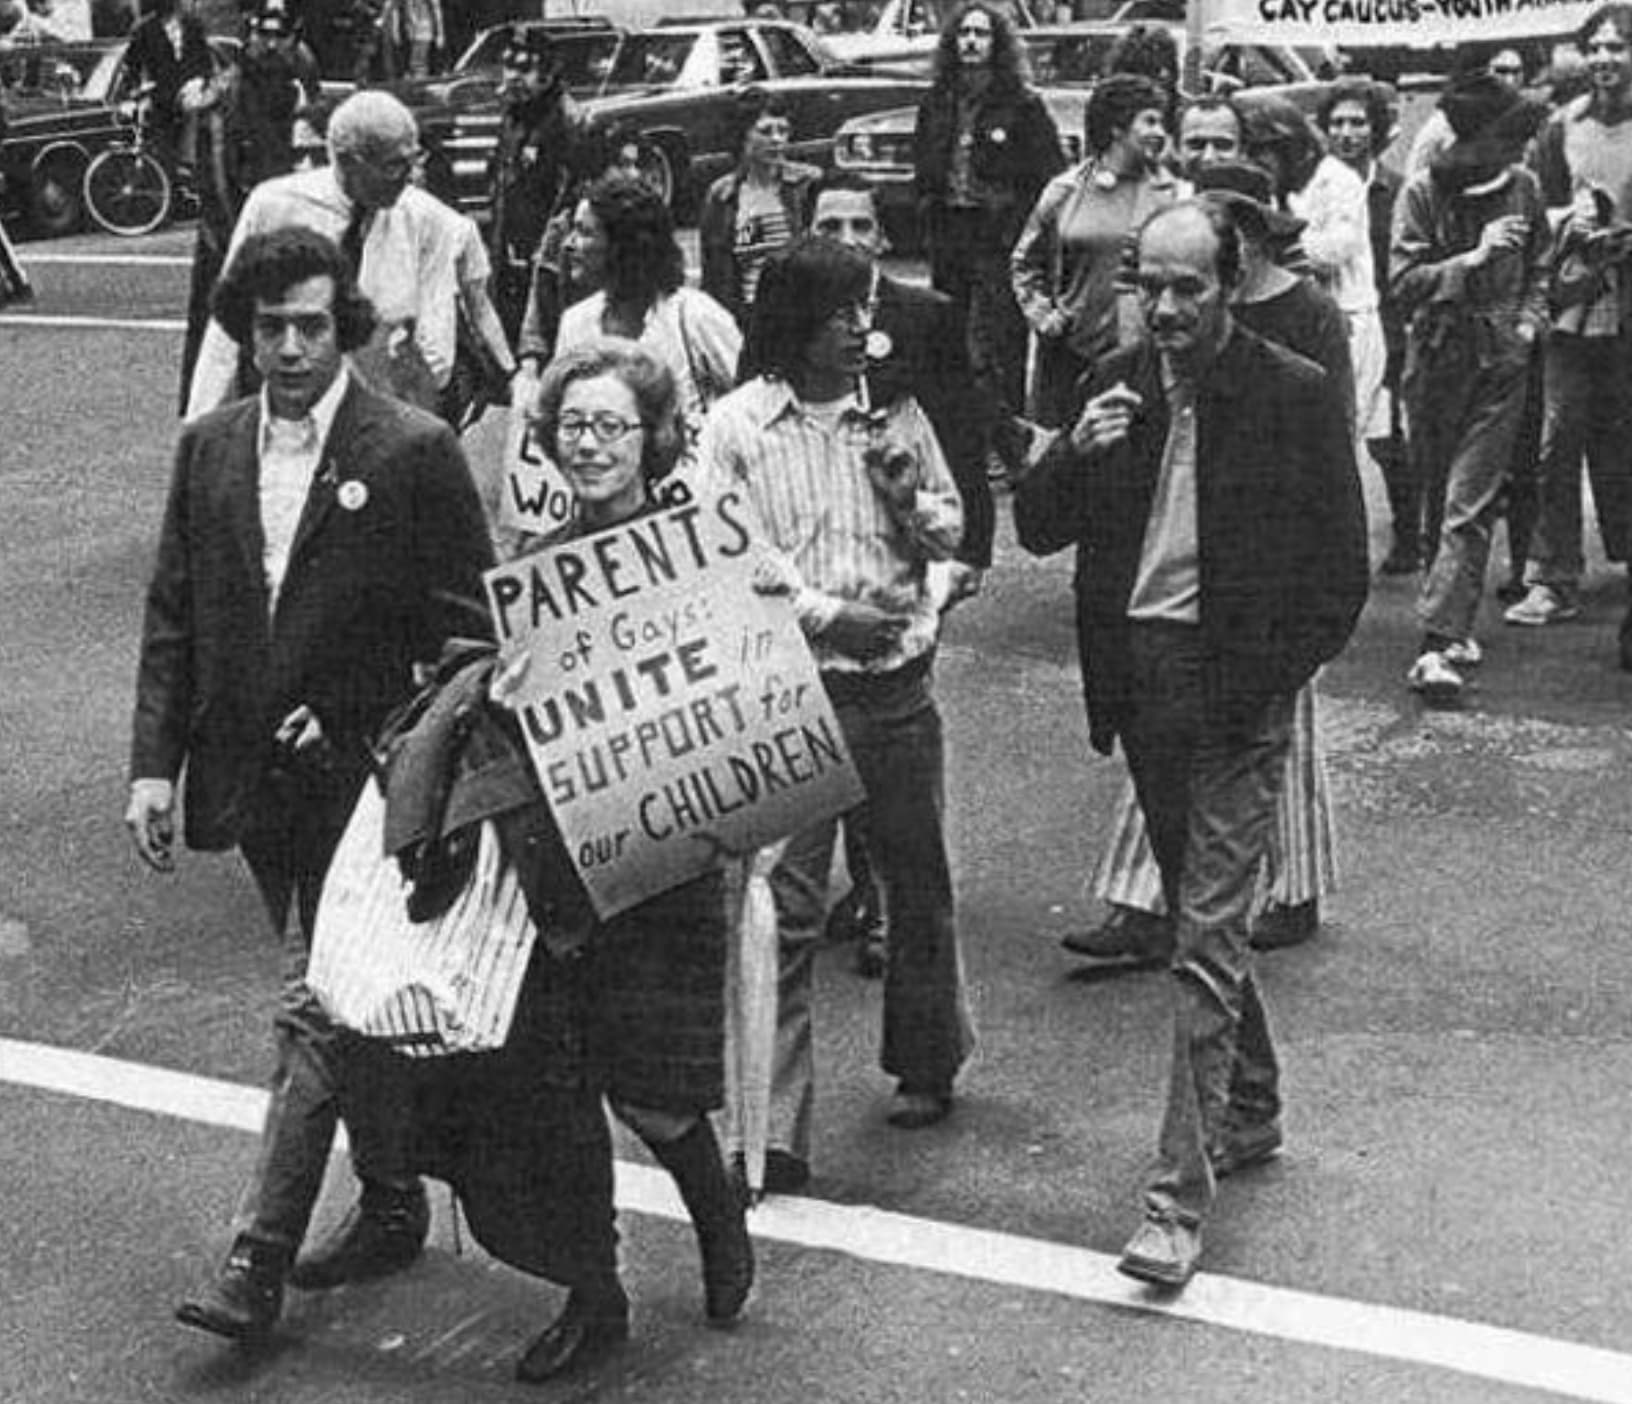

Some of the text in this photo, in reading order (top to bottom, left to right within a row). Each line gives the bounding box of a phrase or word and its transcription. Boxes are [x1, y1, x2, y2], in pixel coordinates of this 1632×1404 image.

[491, 493, 749, 639] PARENTS
[524, 624, 773, 745] UNITE in
[560, 630, 592, 671] of
[547, 674, 810, 805] SUPPORT for
[579, 716, 844, 868] our CHILDREN
